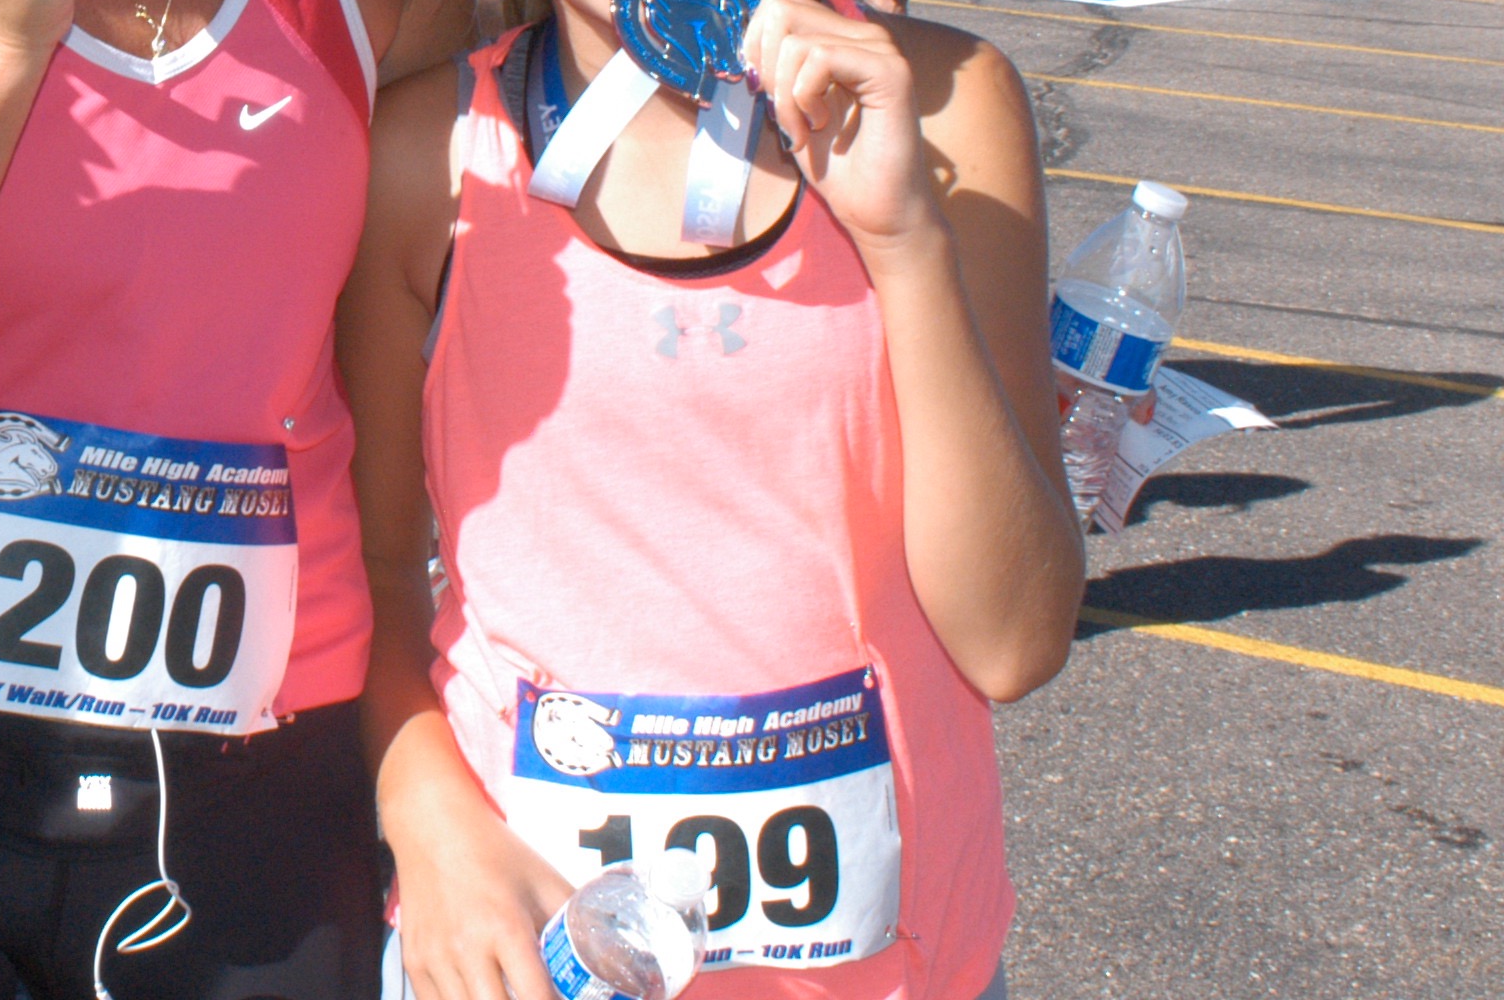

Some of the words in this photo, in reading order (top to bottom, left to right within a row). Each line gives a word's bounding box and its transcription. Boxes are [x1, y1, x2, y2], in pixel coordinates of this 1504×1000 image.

[79, 446, 138, 472] Mile
[141, 456, 200, 480] High
[67, 468, 216, 514] MUSTANG
[7, 684, 126, 716] Walk/Run
[151, 702, 193, 722] 10K
[194, 706, 237, 725] Run
[631, 713, 690, 736] Mile
[693, 715, 755, 737] High
[762, 692, 863, 731] Academy
[626, 735, 778, 767] MUSTANG
[784, 712, 870, 759] MOSEY
[761, 944, 804, 960] 10K
[808, 938, 852, 959] Run
